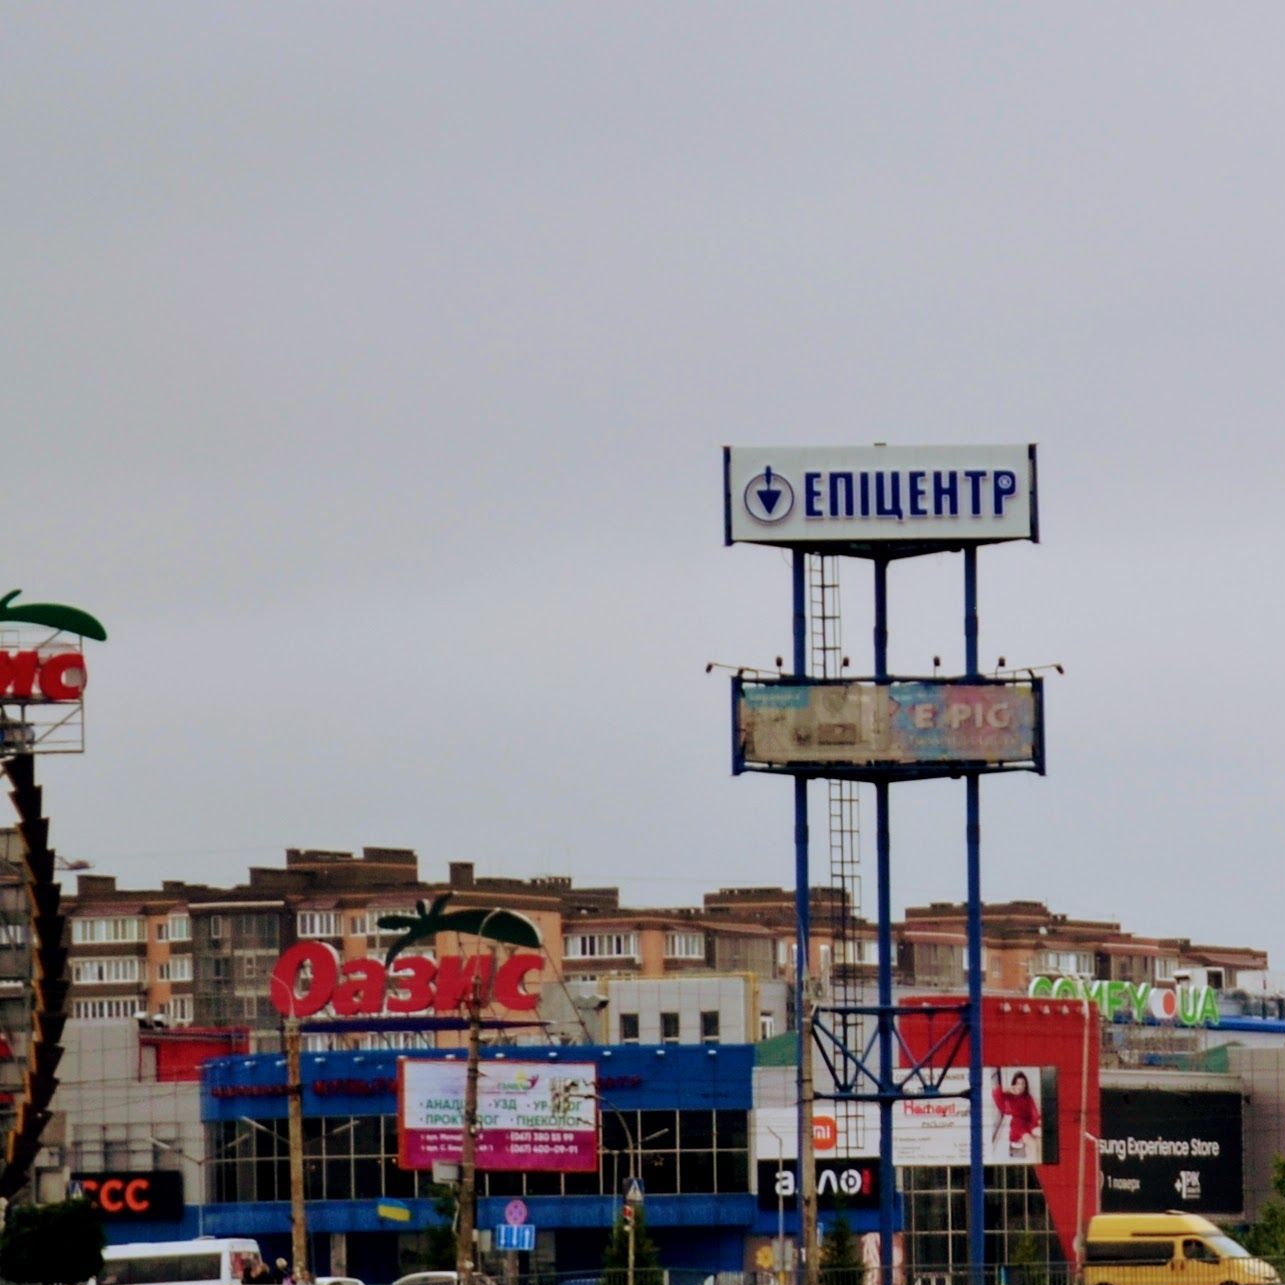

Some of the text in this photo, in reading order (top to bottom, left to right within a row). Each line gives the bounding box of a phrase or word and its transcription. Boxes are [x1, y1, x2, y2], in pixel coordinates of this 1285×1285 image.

[804, 470, 1017, 521] ЕПІЦЕНТР
[270, 940, 545, 1018] Оазис
[1099, 1136, 1220, 1160] sung Experience Store
[83, 1178, 149, 1212] CC
